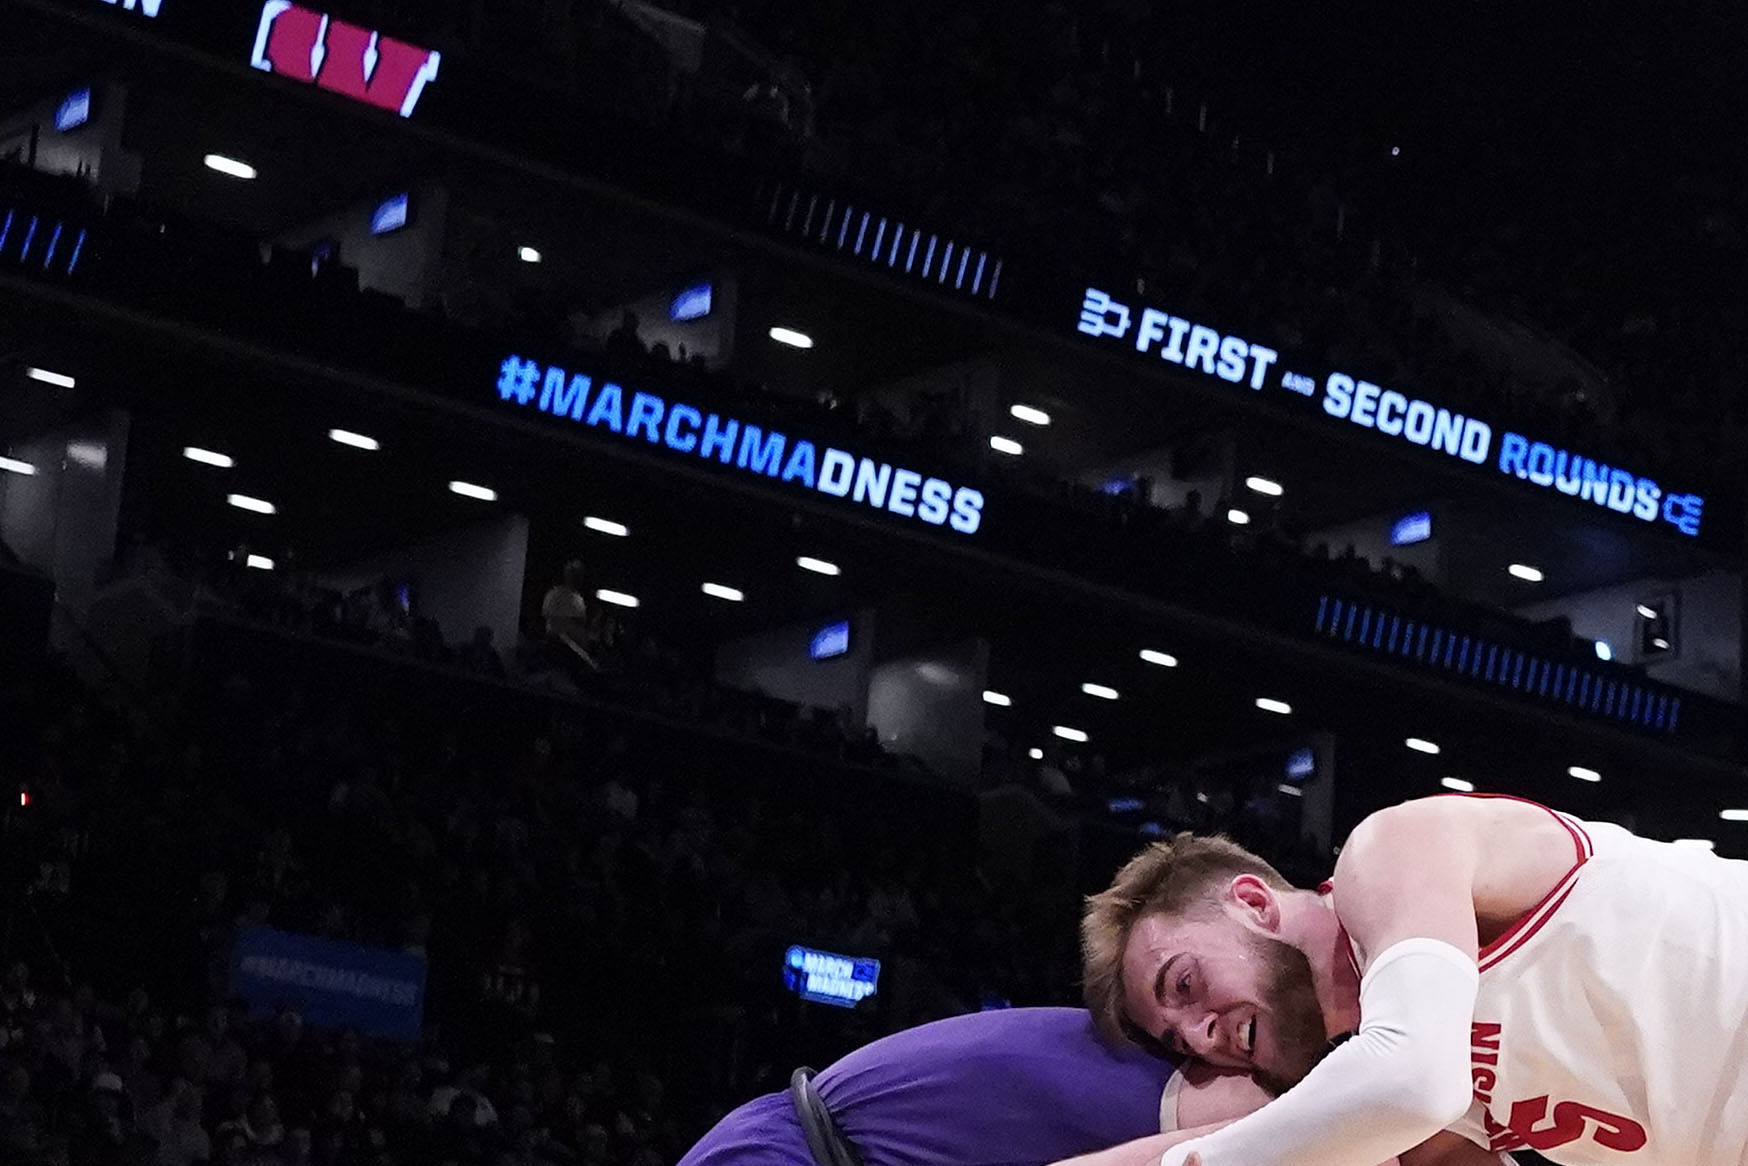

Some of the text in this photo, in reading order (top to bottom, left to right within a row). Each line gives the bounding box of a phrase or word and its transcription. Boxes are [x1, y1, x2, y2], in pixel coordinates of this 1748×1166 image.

[497, 354, 985, 534] #MARCHMADNESS
[1135, 306, 1277, 391] FIRST
[1322, 371, 1489, 464] SECOND
[1498, 431, 1663, 523] ROUNDS
[1507, 1094, 1647, 1153] 5
